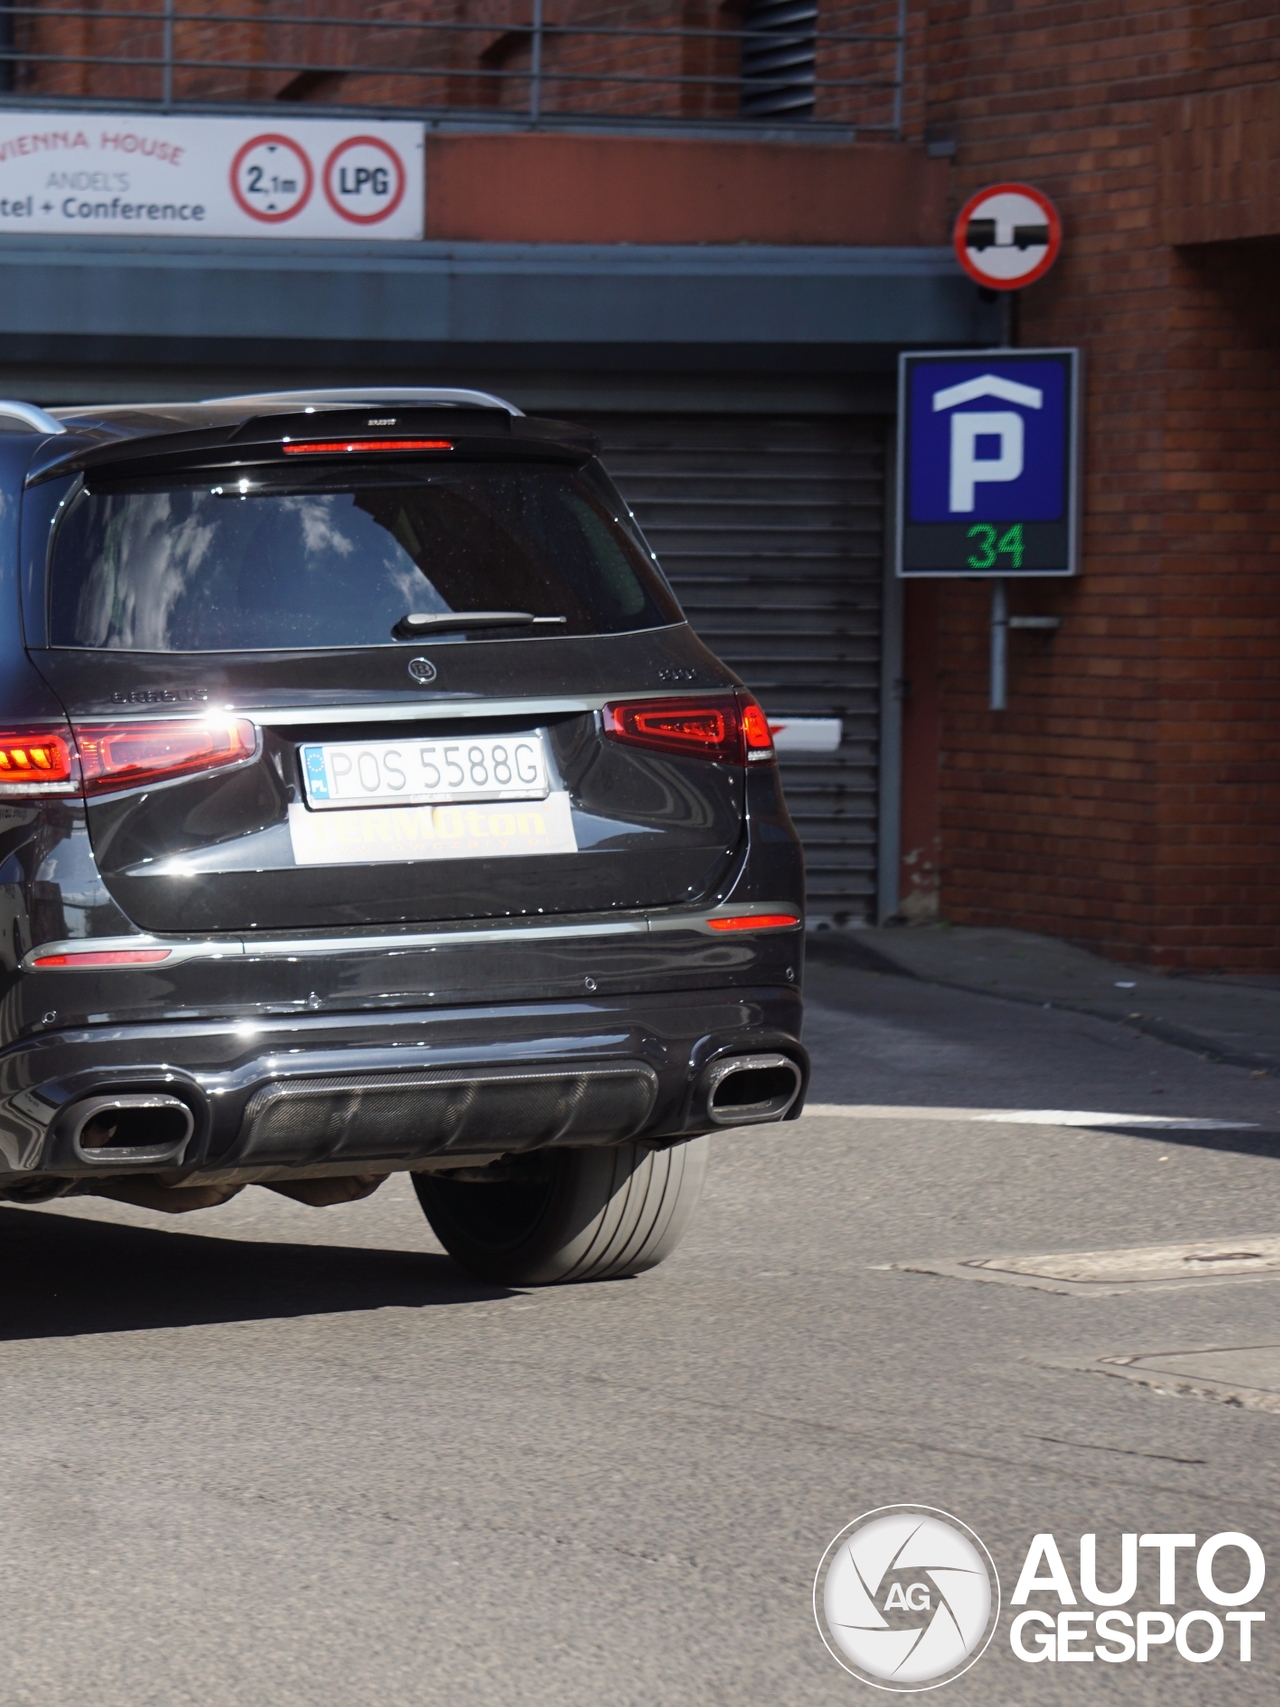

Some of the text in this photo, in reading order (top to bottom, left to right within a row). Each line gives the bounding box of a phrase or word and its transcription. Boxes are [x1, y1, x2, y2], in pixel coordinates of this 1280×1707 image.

[101, 131, 186, 167] HOUSE
[45, 171, 131, 193] ANDEL'S
[339, 167, 389, 195] LPG
[62, 198, 206, 222] Conference
[948, 411, 1025, 513] P
[966, 523, 1025, 569] 34
[330, 743, 538, 795] POS 5588G
[312, 779, 328, 794] PL
